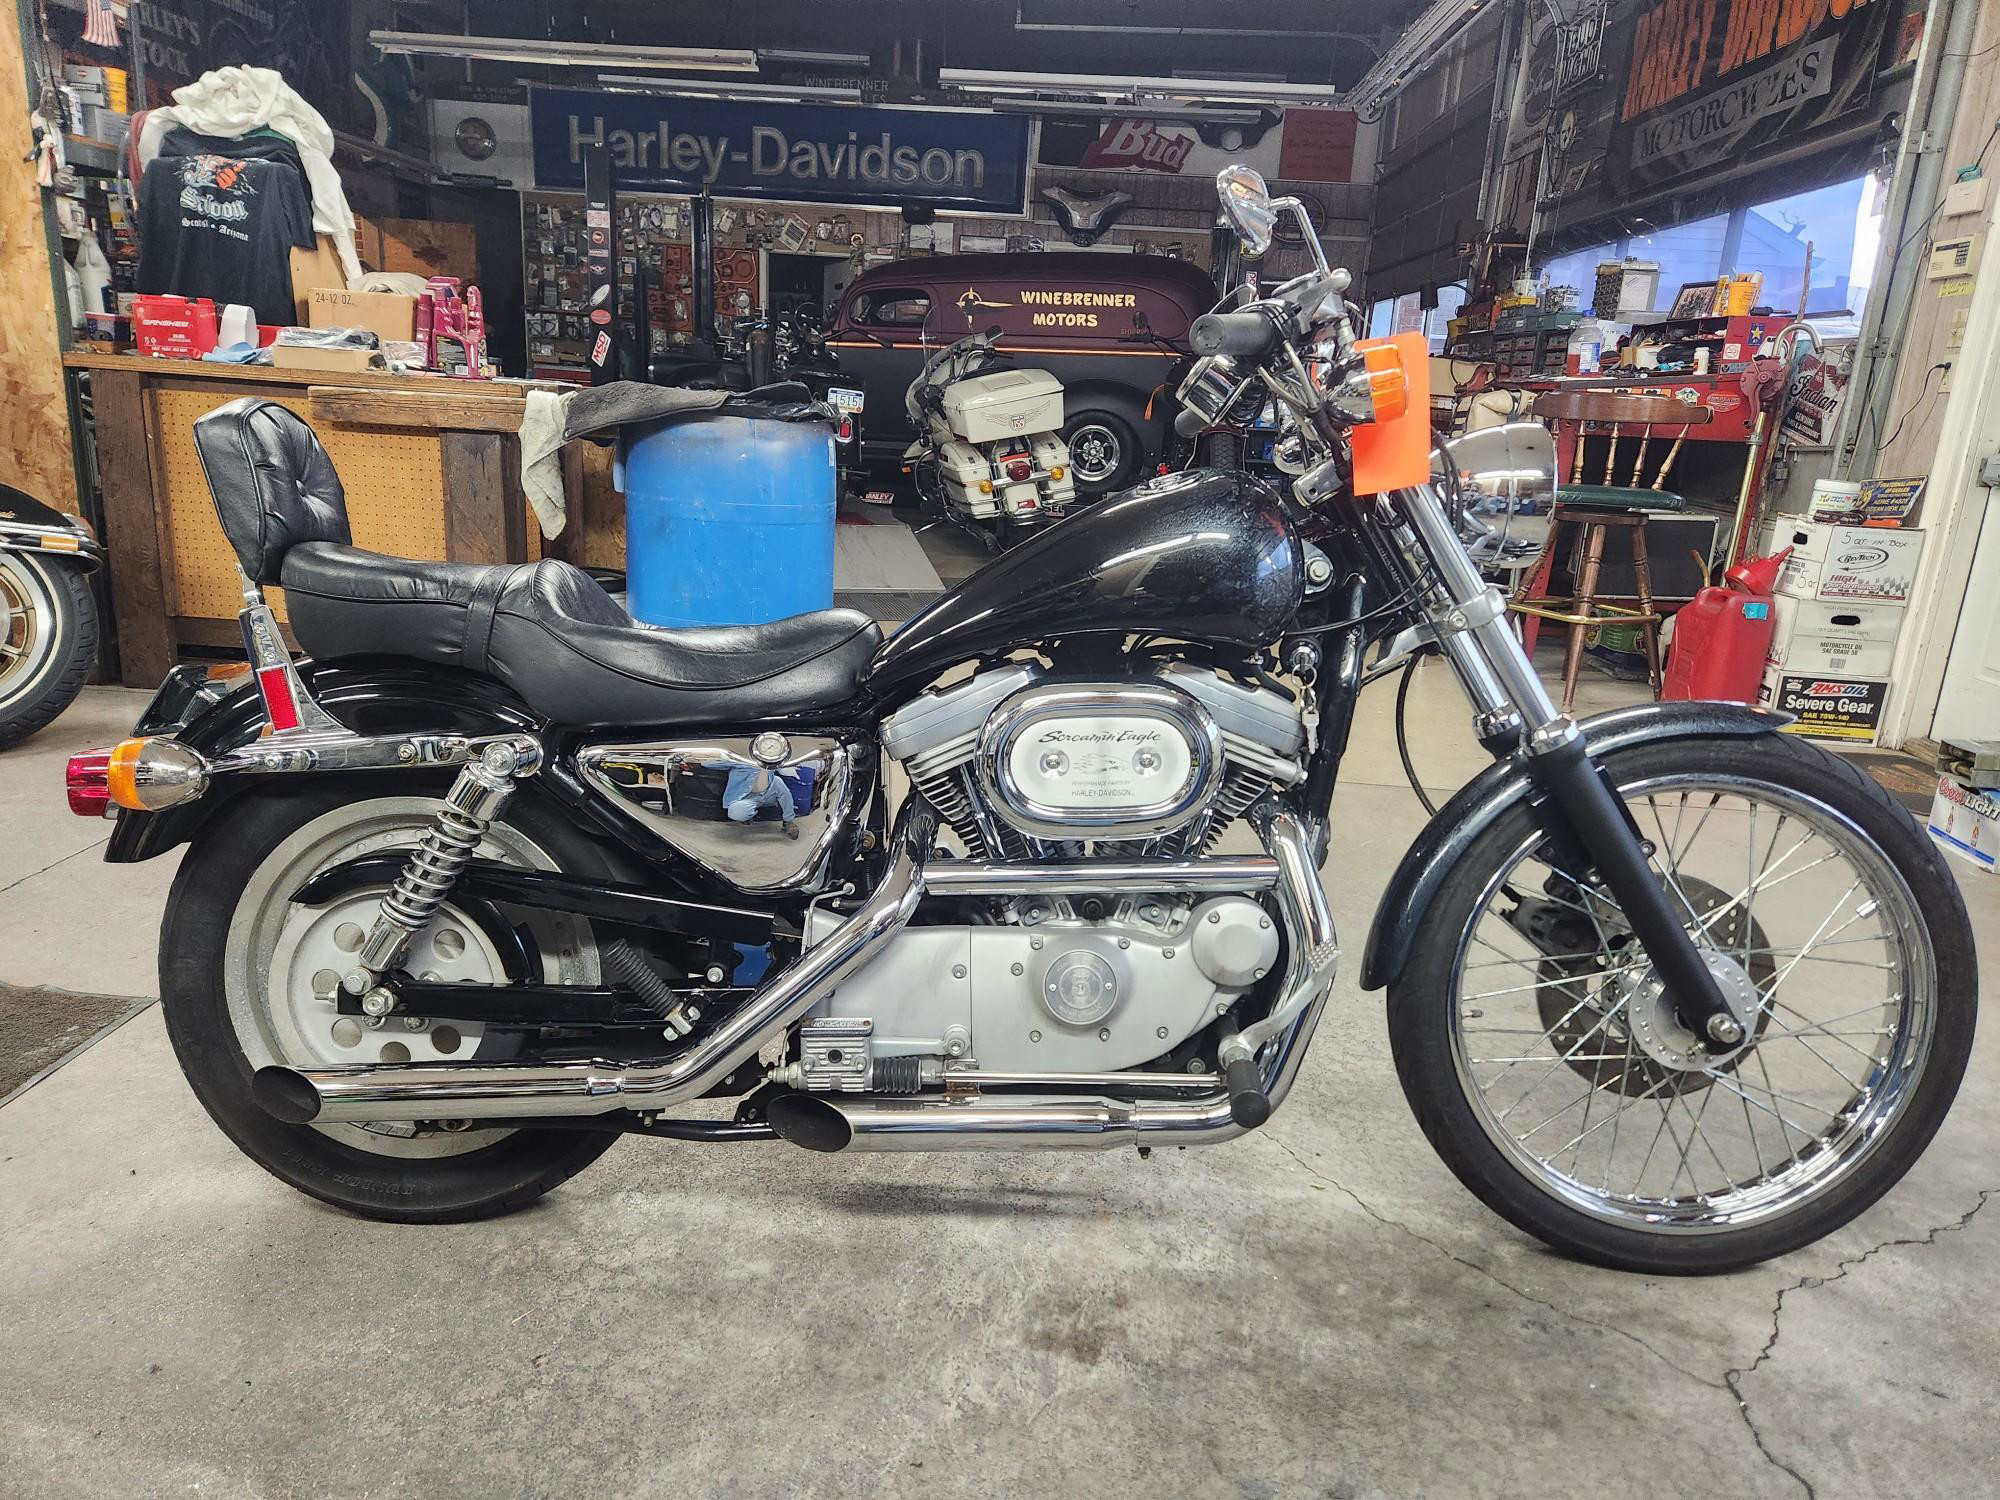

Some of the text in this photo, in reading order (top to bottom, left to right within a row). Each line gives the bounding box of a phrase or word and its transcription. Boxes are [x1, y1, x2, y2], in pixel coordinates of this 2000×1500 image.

[1101, 117, 1194, 167] Bud
[567, 115, 985, 188] Harley-Davidson
[219, 224, 249, 242] Arizona
[315, 292, 338, 304] 24-12
[1020, 291, 1136, 308] WINEBRENNER
[1033, 313, 1098, 328] MOTORS
[593, 333, 607, 363] MSD
[1790, 374, 1839, 414] Indian
[1841, 531, 1853, 545] 5
[1888, 539, 1909, 549] BOX
[1830, 574, 1858, 583] HIGH
[1825, 582, 1880, 592] performance
[1820, 641, 1853, 650] MOTORCYCLE
[1822, 647, 1833, 655] SAE
[1833, 648, 1850, 656] GRADE
[1811, 683, 1867, 695] AMSOIL
[1785, 694, 1874, 714] Severe Gear
[1802, 711, 1818, 719] SAE
[1117, 730, 1162, 746] Eagle
[1071, 788, 1132, 798] HARLEY-DAVIDSON
[1965, 794, 2000, 821] LIGHT
